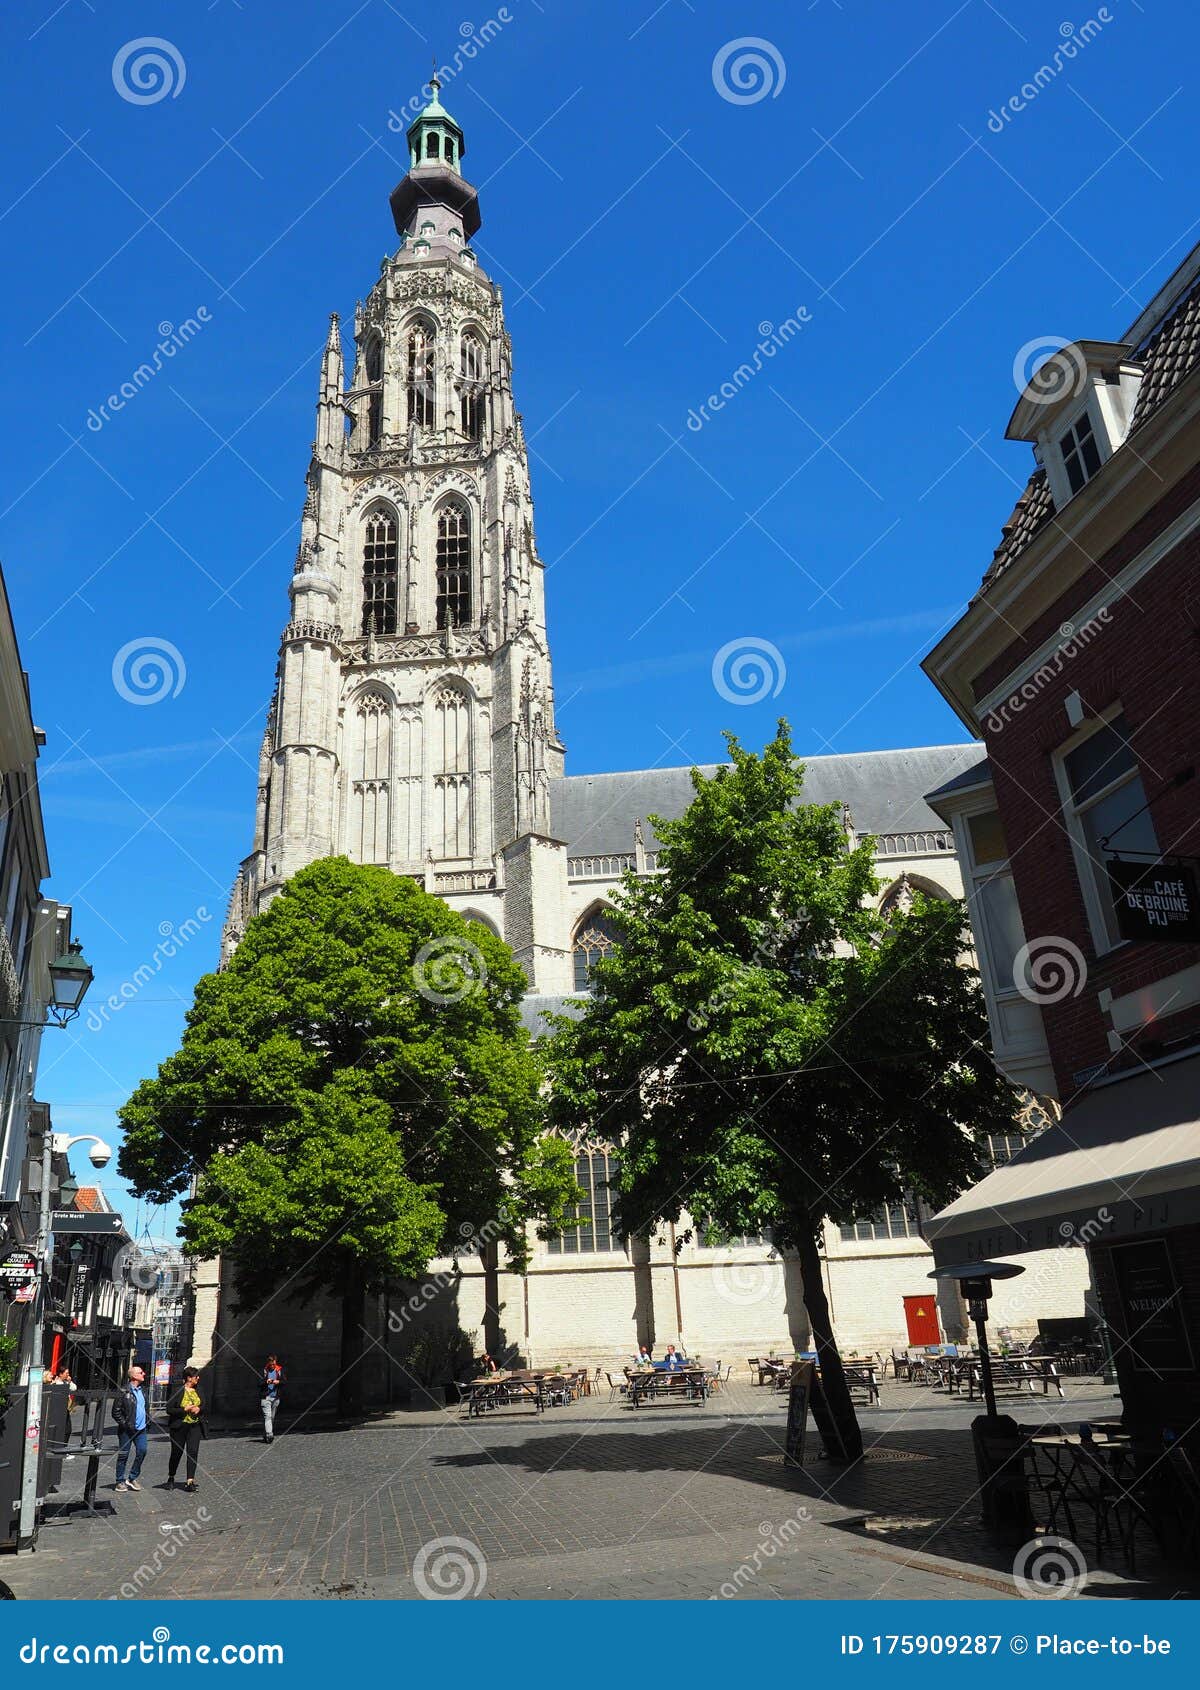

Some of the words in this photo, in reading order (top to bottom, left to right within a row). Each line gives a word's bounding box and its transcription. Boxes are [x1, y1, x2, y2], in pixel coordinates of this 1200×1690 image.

[1127, 893, 1142, 908] DE
[1144, 895, 1190, 912] BRUINE
[1147, 911, 1168, 926] PIJ
[0, 1267, 36, 1277] PIZZA
[79, 1274, 86, 1284] DE
